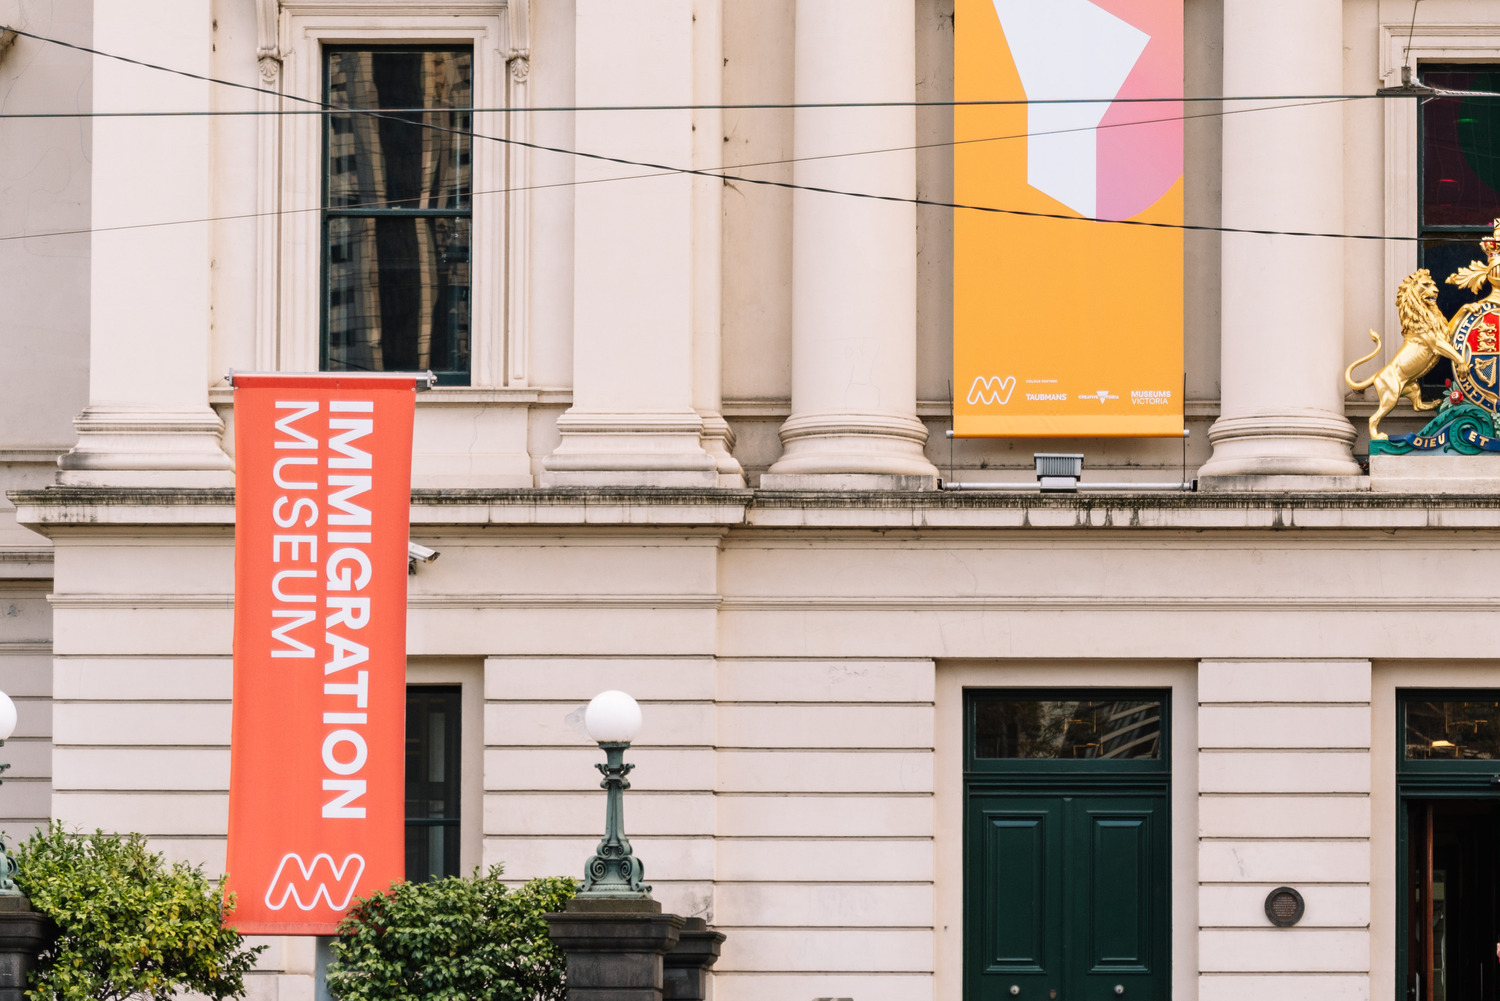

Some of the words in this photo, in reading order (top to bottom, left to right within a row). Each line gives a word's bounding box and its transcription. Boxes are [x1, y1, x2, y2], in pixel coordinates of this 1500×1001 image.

[1454, 320, 1471, 350] SOIT
[1026, 393, 1067, 401] TAUBMANS
[1131, 390, 1171, 398] MUSEUMS
[1413, 433, 1445, 448] DIEU
[1469, 431, 1489, 446] ET
[271, 401, 320, 659] MUSEUM
[322, 401, 374, 819] IMMIGRATION
